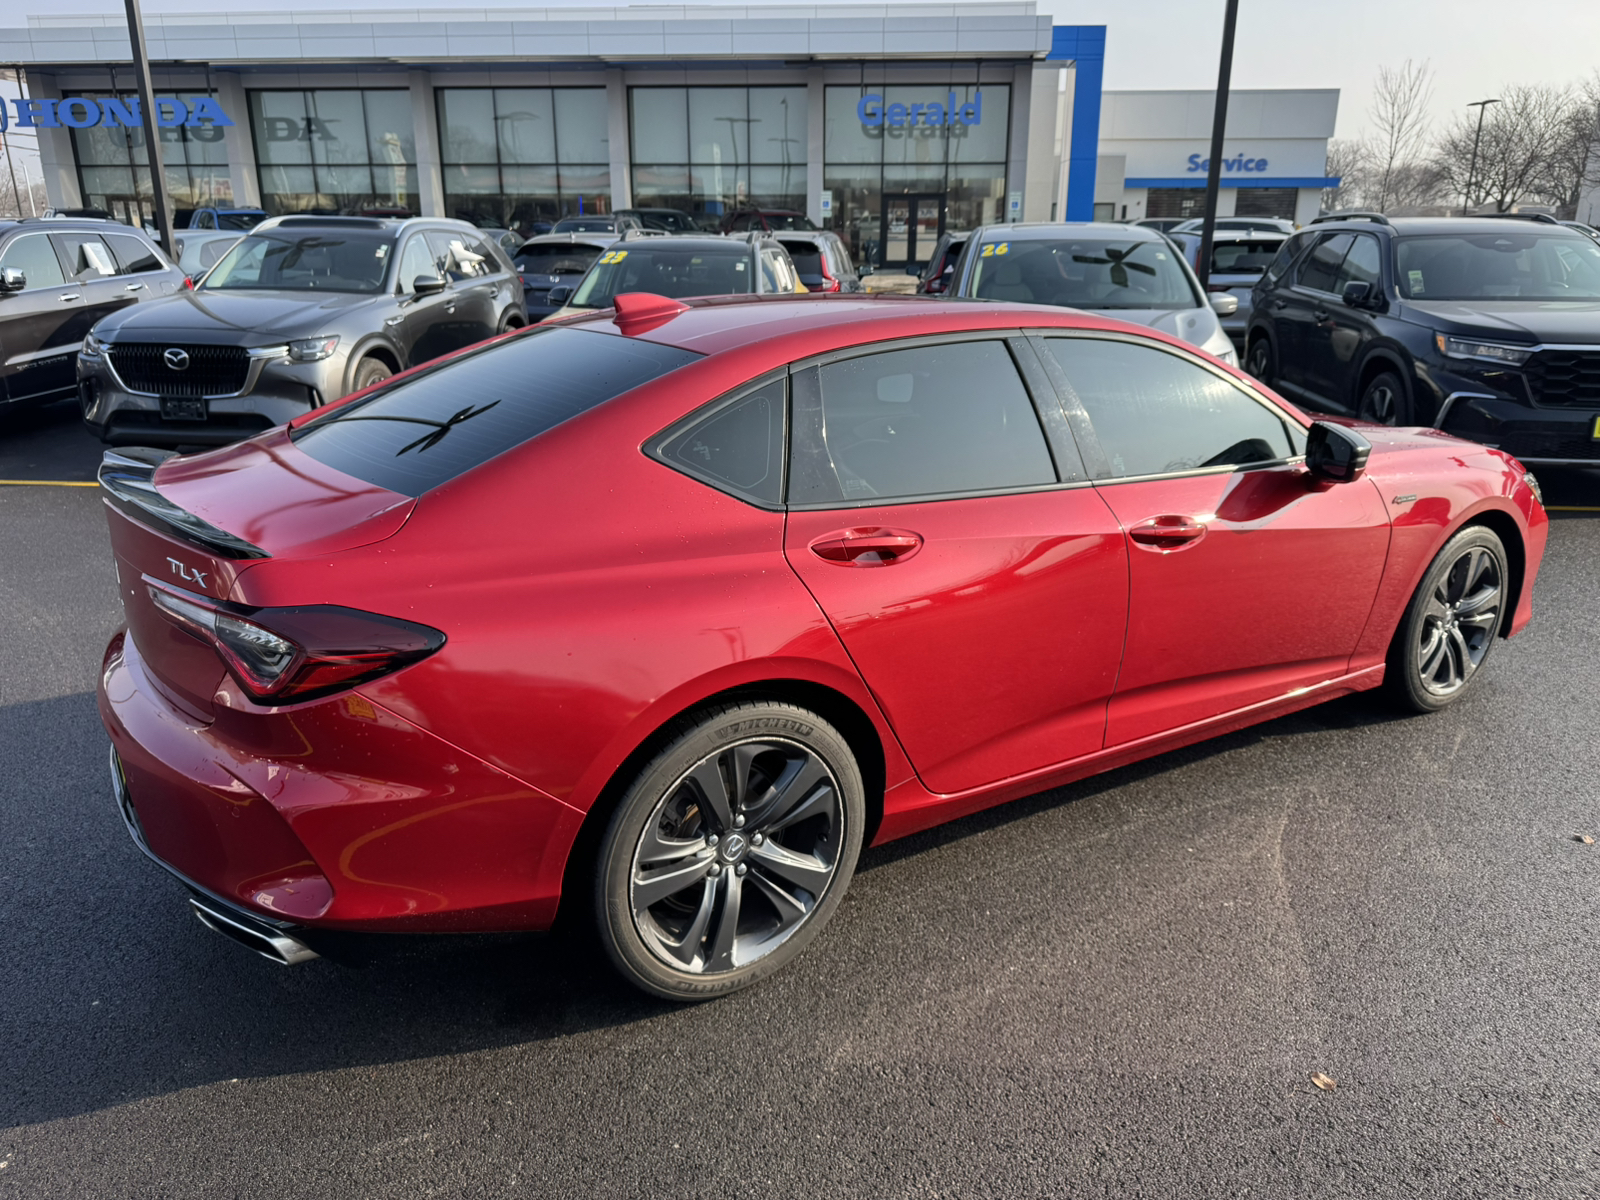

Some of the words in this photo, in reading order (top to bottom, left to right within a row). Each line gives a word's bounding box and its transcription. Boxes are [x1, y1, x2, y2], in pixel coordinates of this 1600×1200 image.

[10, 97, 236, 128] HONDA
[857, 92, 982, 126] Gerald
[1186, 153, 1268, 172] Sevice
[981, 243, 1008, 257] 26
[166, 556, 208, 588] TLX
[738, 718, 811, 735] MICHELIN
